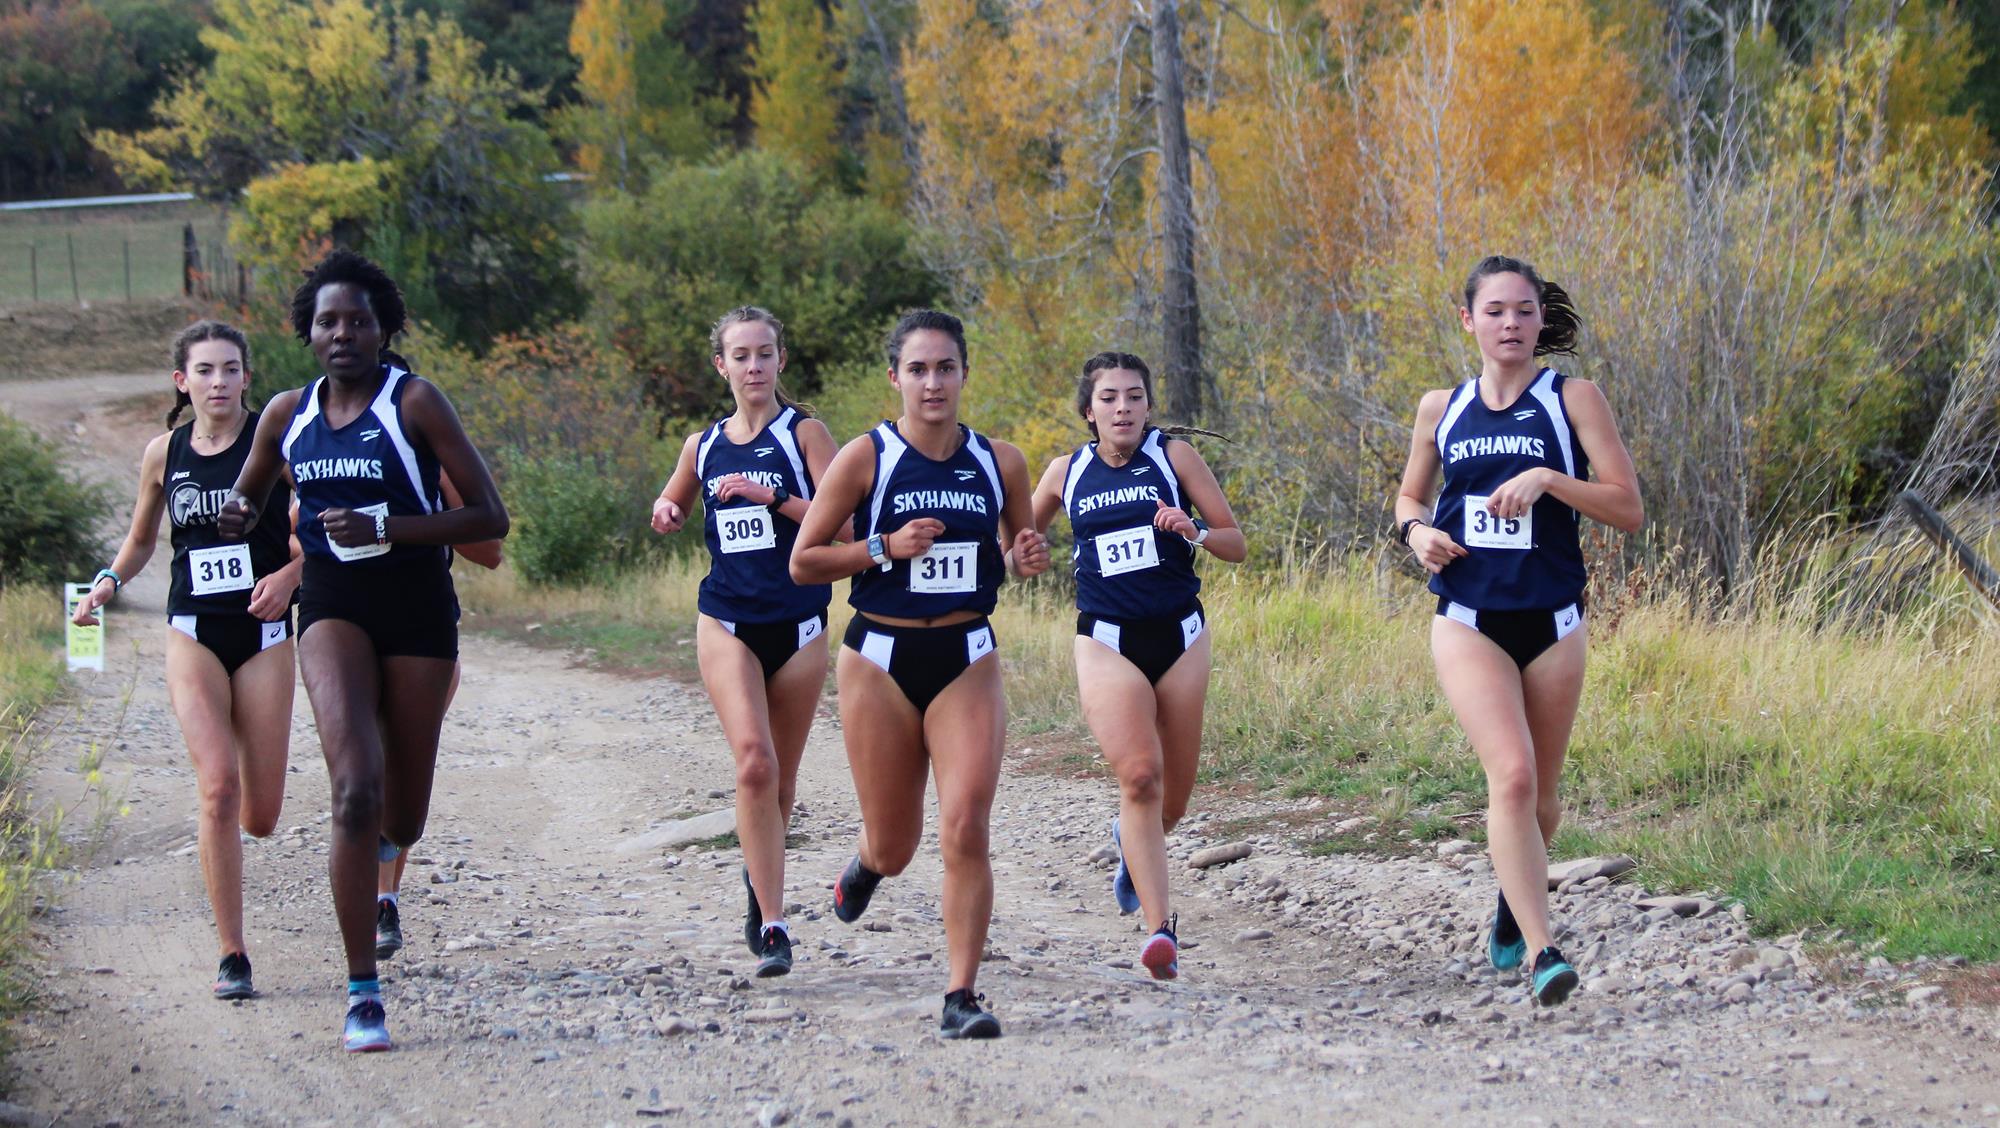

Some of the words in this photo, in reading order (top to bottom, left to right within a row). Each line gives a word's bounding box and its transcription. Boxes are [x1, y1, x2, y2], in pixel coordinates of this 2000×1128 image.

[1450, 436, 1545, 464] SKYHAWKS
[295, 458, 383, 483] SKYHAWKS
[893, 490, 987, 516] SKYHAWKS
[1078, 485, 1160, 516] SKYHAWKS
[724, 517, 764, 541] 309
[1473, 510, 1520, 535] 315
[1106, 537, 1145, 563] 317
[200, 557, 242, 582] 318
[921, 556, 964, 580] 311
